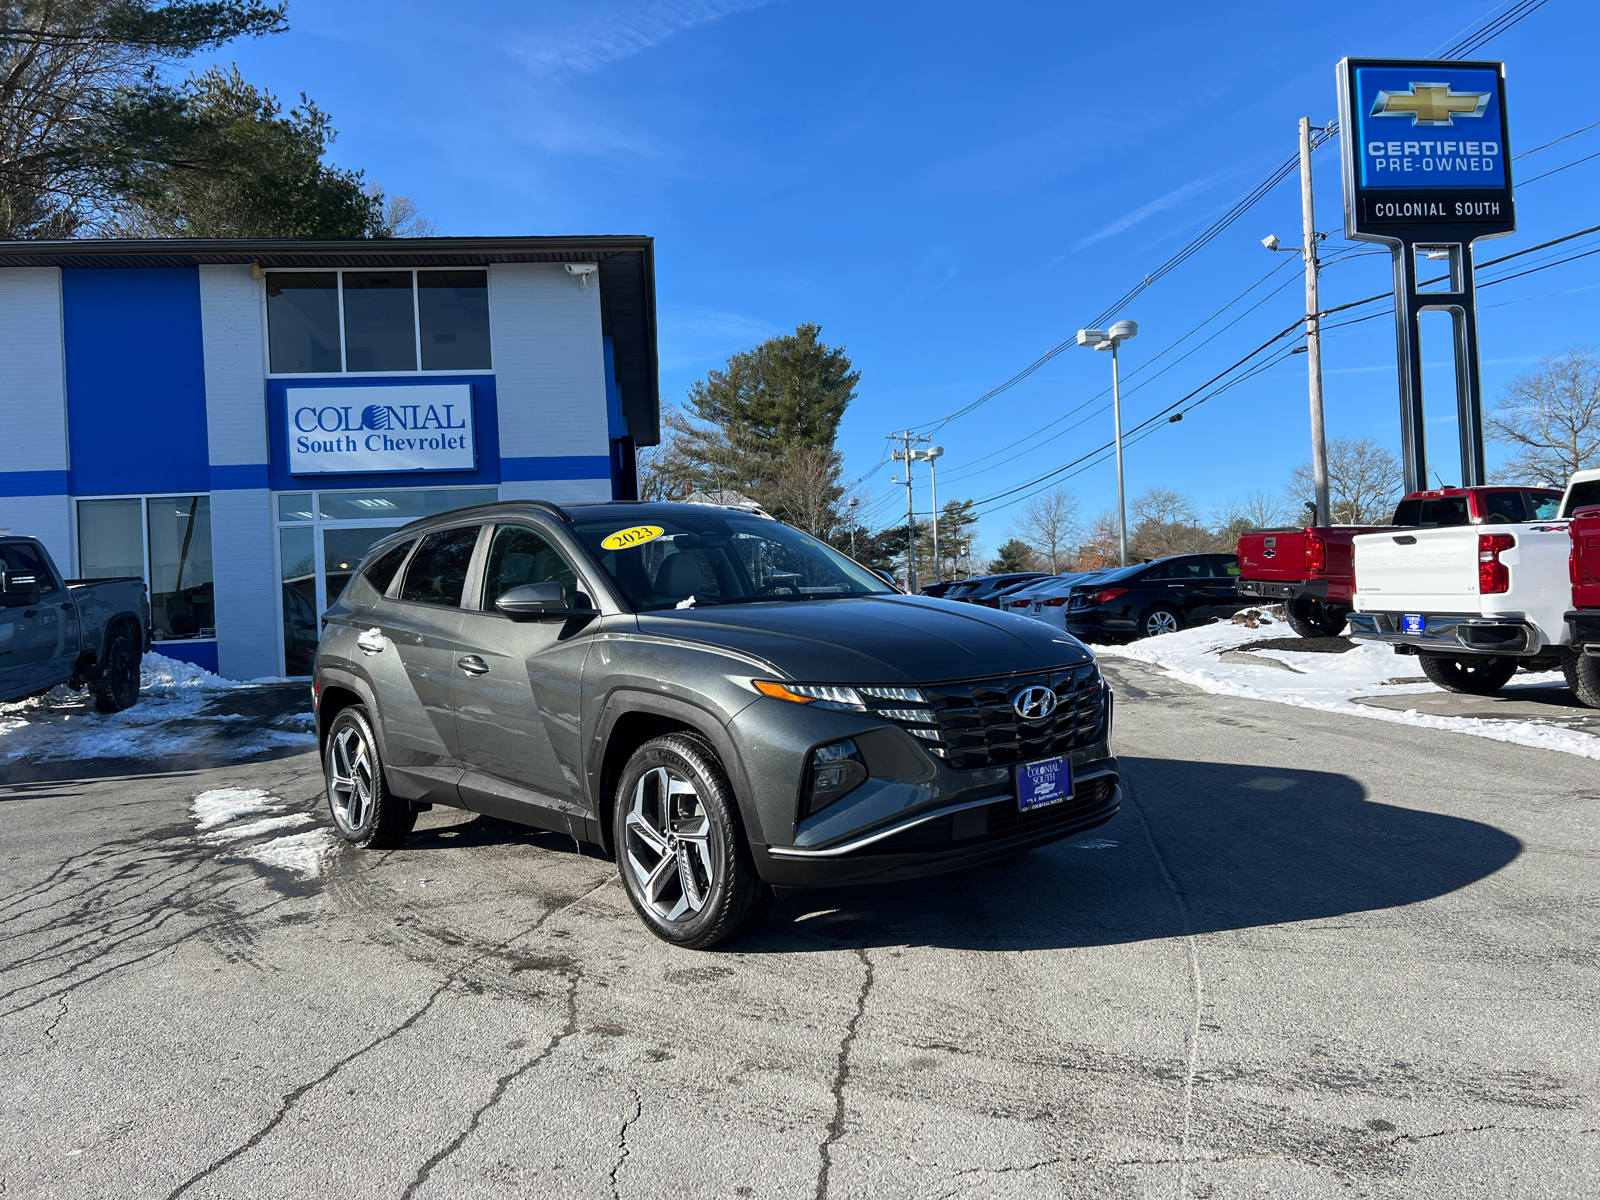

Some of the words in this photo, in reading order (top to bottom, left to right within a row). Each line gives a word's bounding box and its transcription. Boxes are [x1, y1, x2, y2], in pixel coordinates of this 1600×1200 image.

[1368, 141, 1499, 156] CERTIFIED
[1375, 157, 1494, 172] PRE-OWNED
[1375, 202, 1447, 217] COLONIAL
[1455, 202, 1500, 216] SOUTH
[294, 404, 466, 433] COLONIAL
[297, 435, 358, 453] South
[364, 433, 467, 452] Chevrolet
[612, 527, 653, 547] 2023
[661, 751, 696, 779] MICHELIN
[1027, 763, 1061, 778] COLONIAL
[1032, 772, 1056, 785] SOUTH
